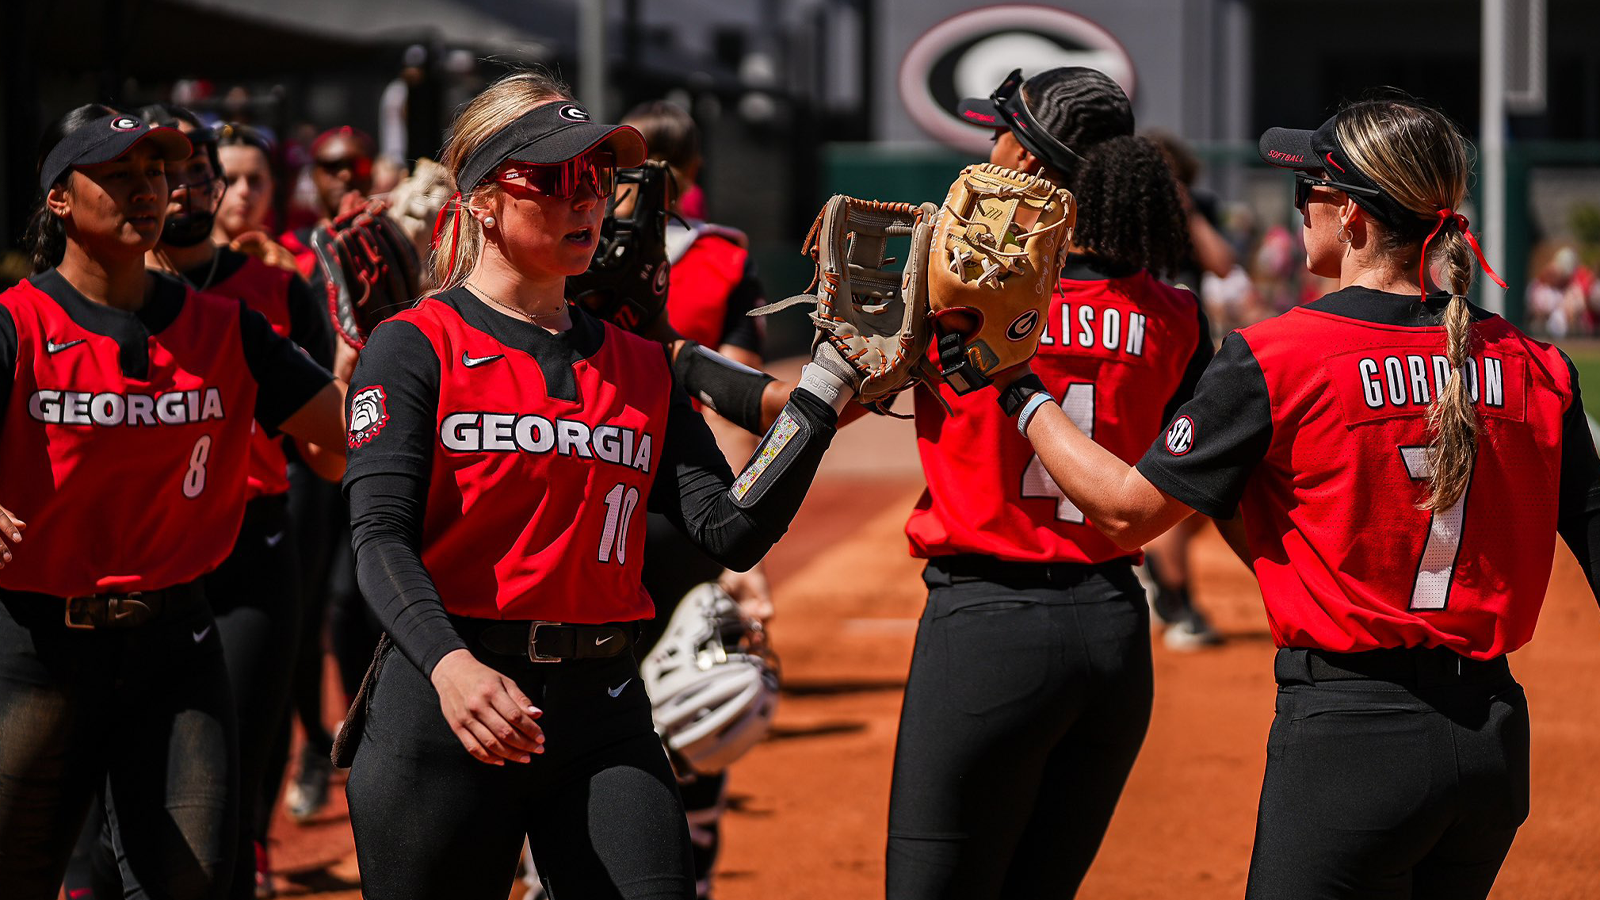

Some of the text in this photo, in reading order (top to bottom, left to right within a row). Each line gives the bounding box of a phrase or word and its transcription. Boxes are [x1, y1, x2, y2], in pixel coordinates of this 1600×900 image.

[1267, 149, 1305, 163] SOFTBALL
[1039, 303, 1147, 357] LISON
[28, 387, 225, 427] GEORGIA
[1358, 355, 1504, 409] GORDON
[439, 410, 652, 474] GEORGIA
[1166, 416, 1192, 454] SEC
[182, 434, 212, 499] 8
[597, 482, 640, 566] 10
[1397, 445, 1478, 612] 7
